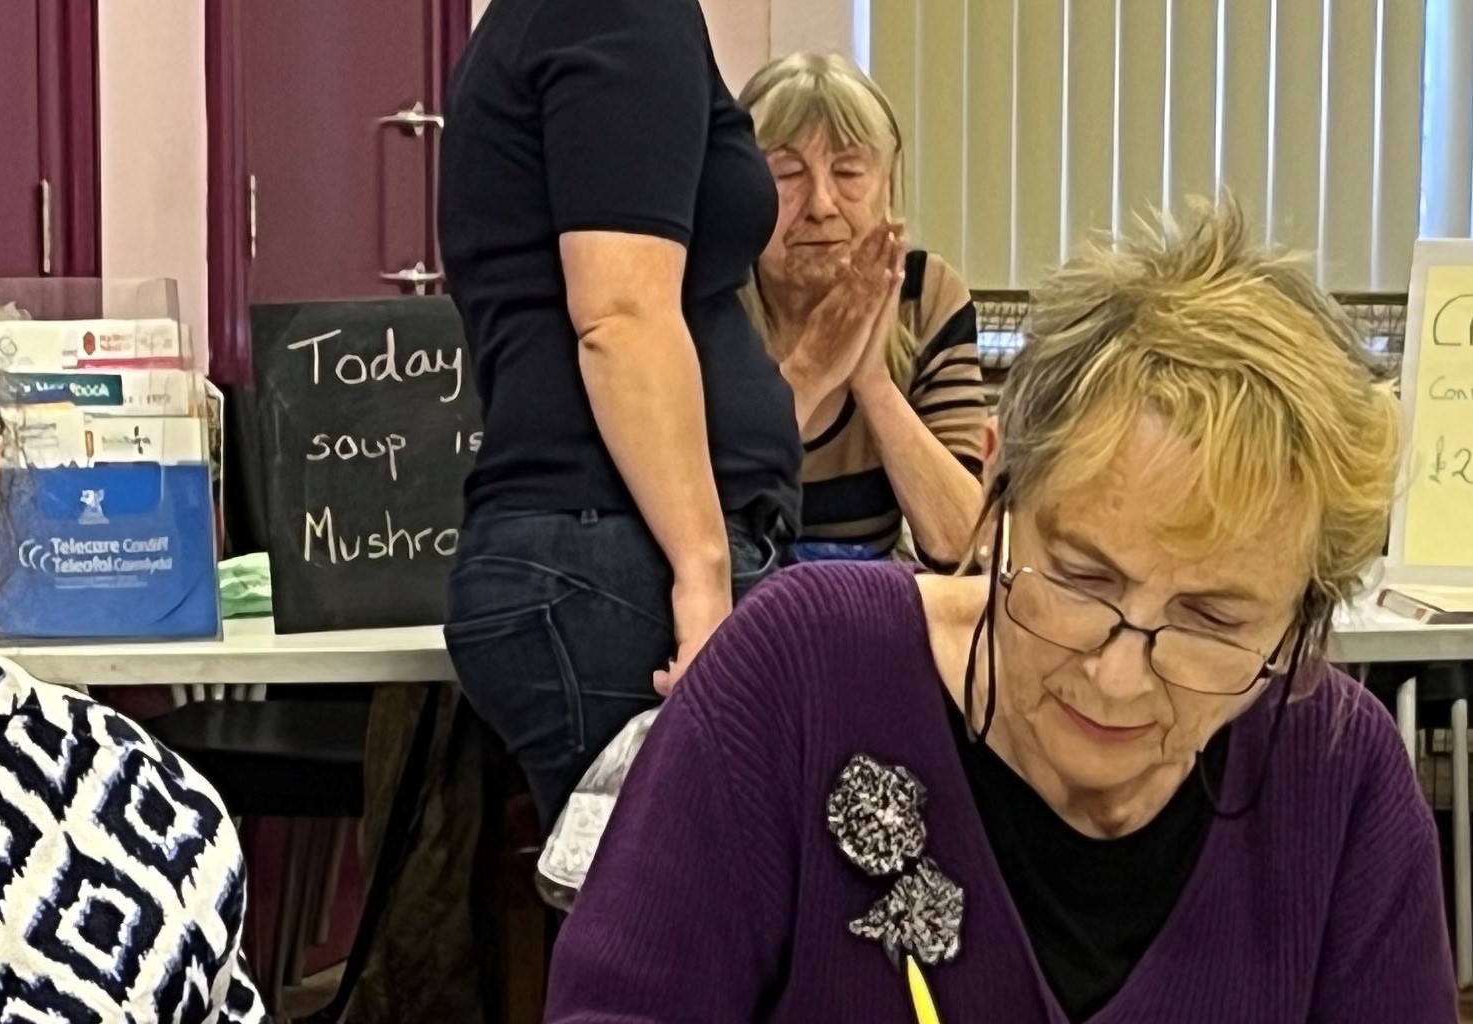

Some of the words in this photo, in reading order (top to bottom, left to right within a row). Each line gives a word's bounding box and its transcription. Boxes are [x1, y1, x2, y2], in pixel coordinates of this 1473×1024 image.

[1433, 293, 1473, 346] C
[287, 328, 463, 403] Today
[1429, 375, 1473, 400] Con
[306, 433, 406, 481] soup
[455, 430, 484, 455] is
[303, 506, 460, 564] Mushro
